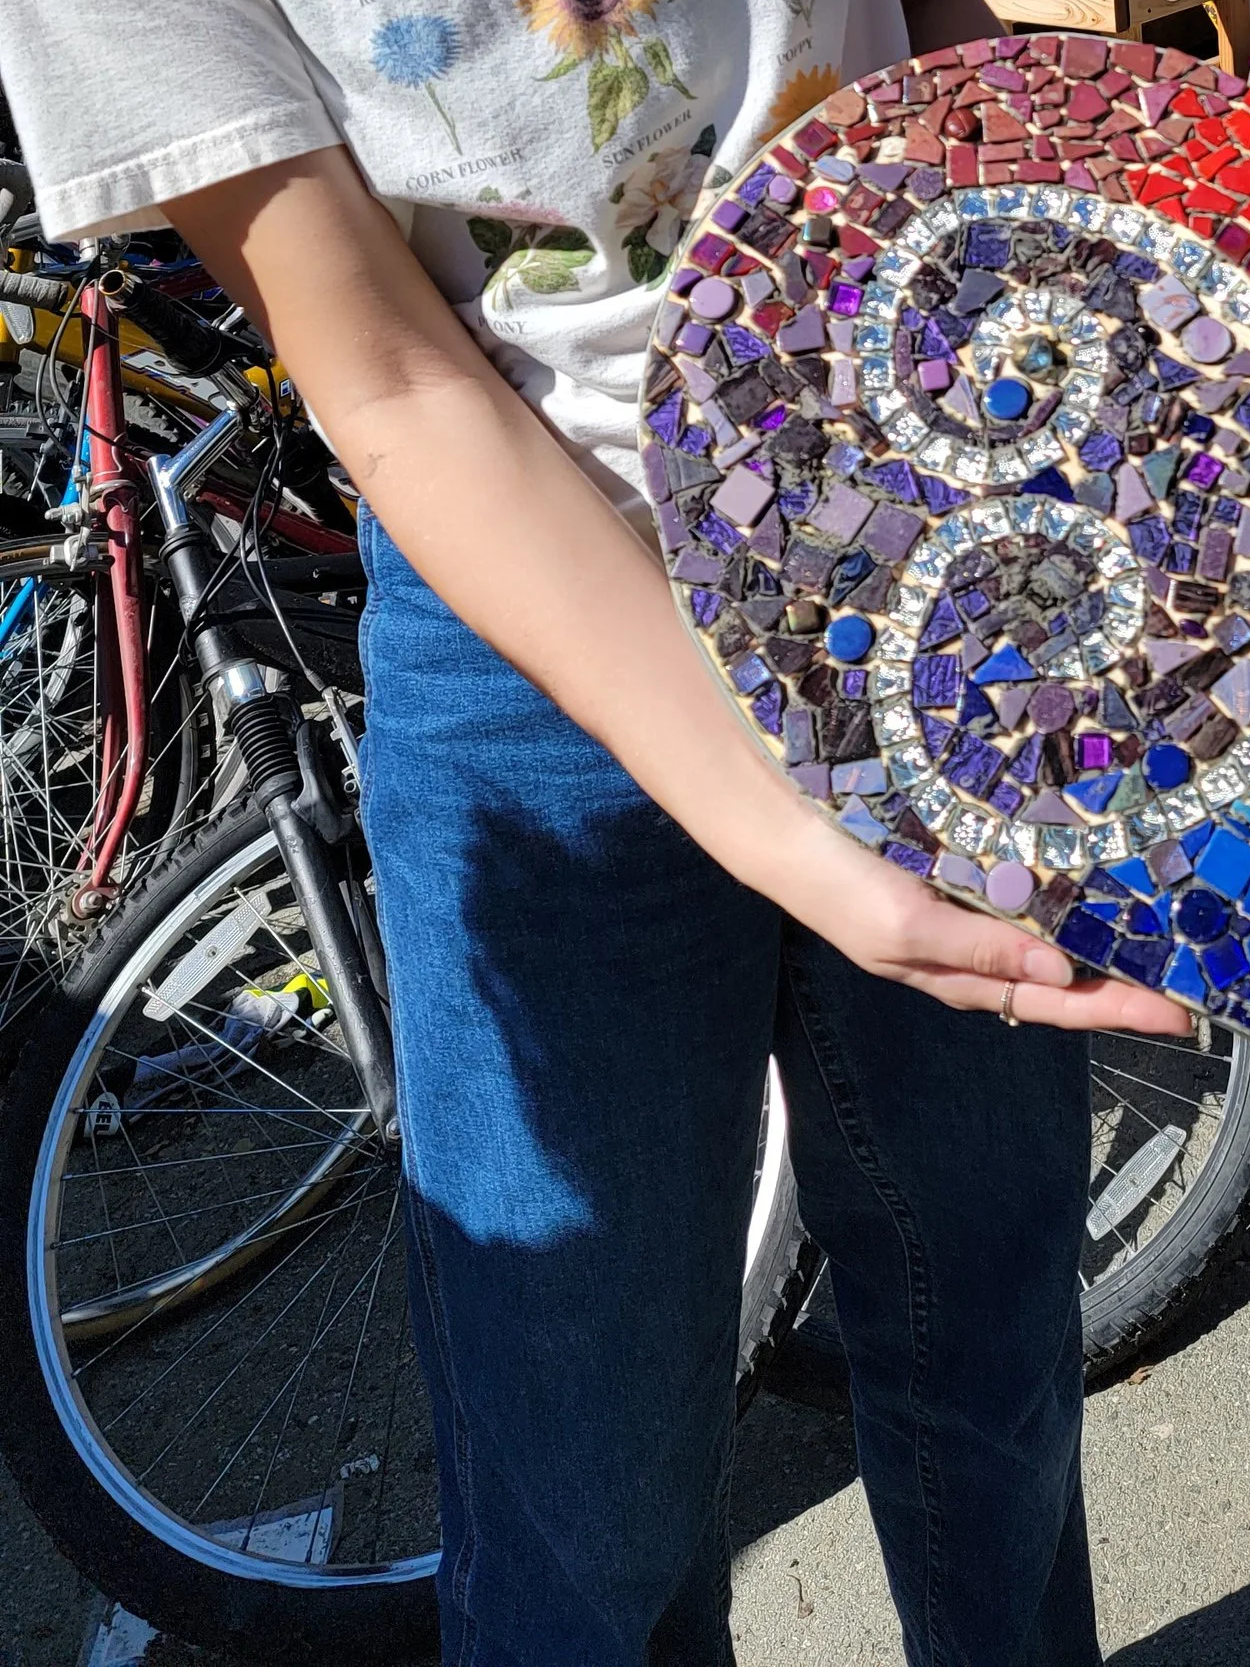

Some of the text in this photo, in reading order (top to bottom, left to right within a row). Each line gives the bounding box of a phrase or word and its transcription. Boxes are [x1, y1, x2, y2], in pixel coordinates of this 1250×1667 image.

[777, 36, 813, 66] POPPY
[602, 109, 692, 168] SUN FLOWER
[405, 148, 523, 191] CORN FLOWER
[478, 316, 526, 335] PONY
